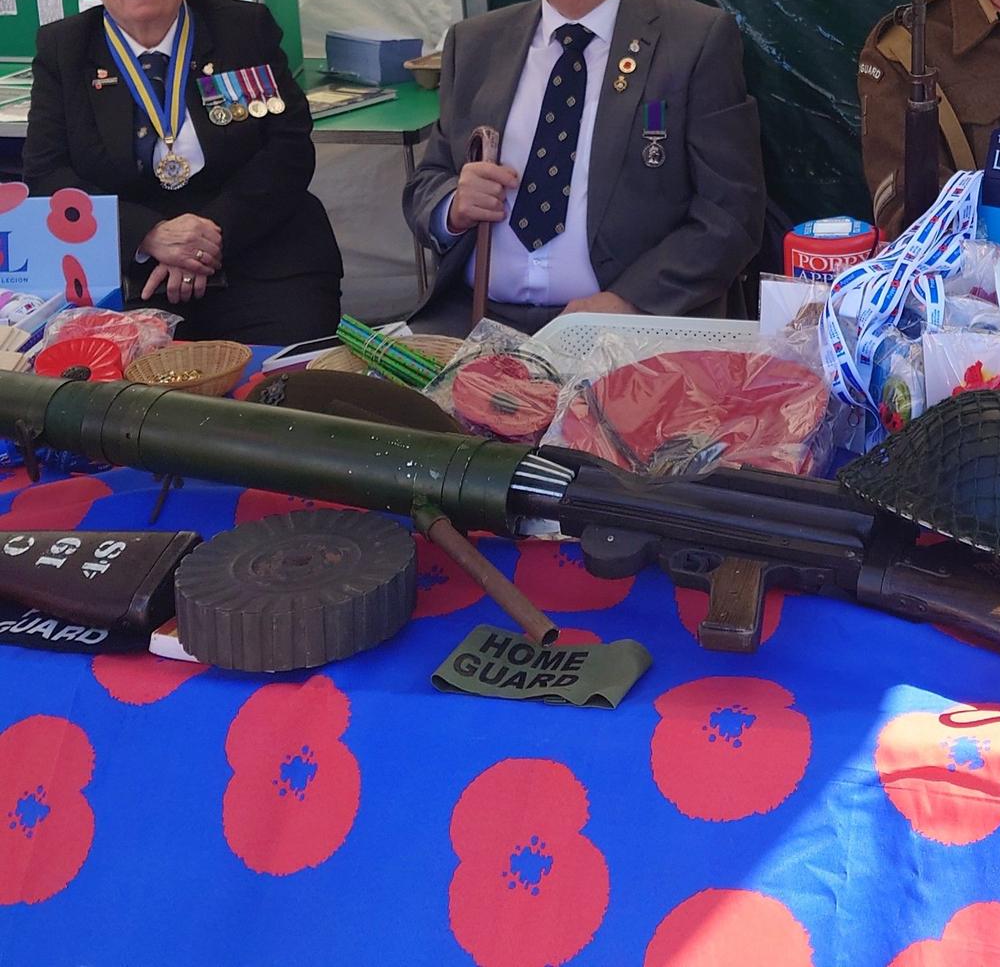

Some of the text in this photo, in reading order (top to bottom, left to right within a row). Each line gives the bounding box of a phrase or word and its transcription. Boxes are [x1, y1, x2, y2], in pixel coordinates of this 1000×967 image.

[860, 64, 881, 79] GUARD
[0, 618, 109, 645] GUARD
[479, 633, 590, 672] HOME
[453, 652, 580, 690] GUARD
